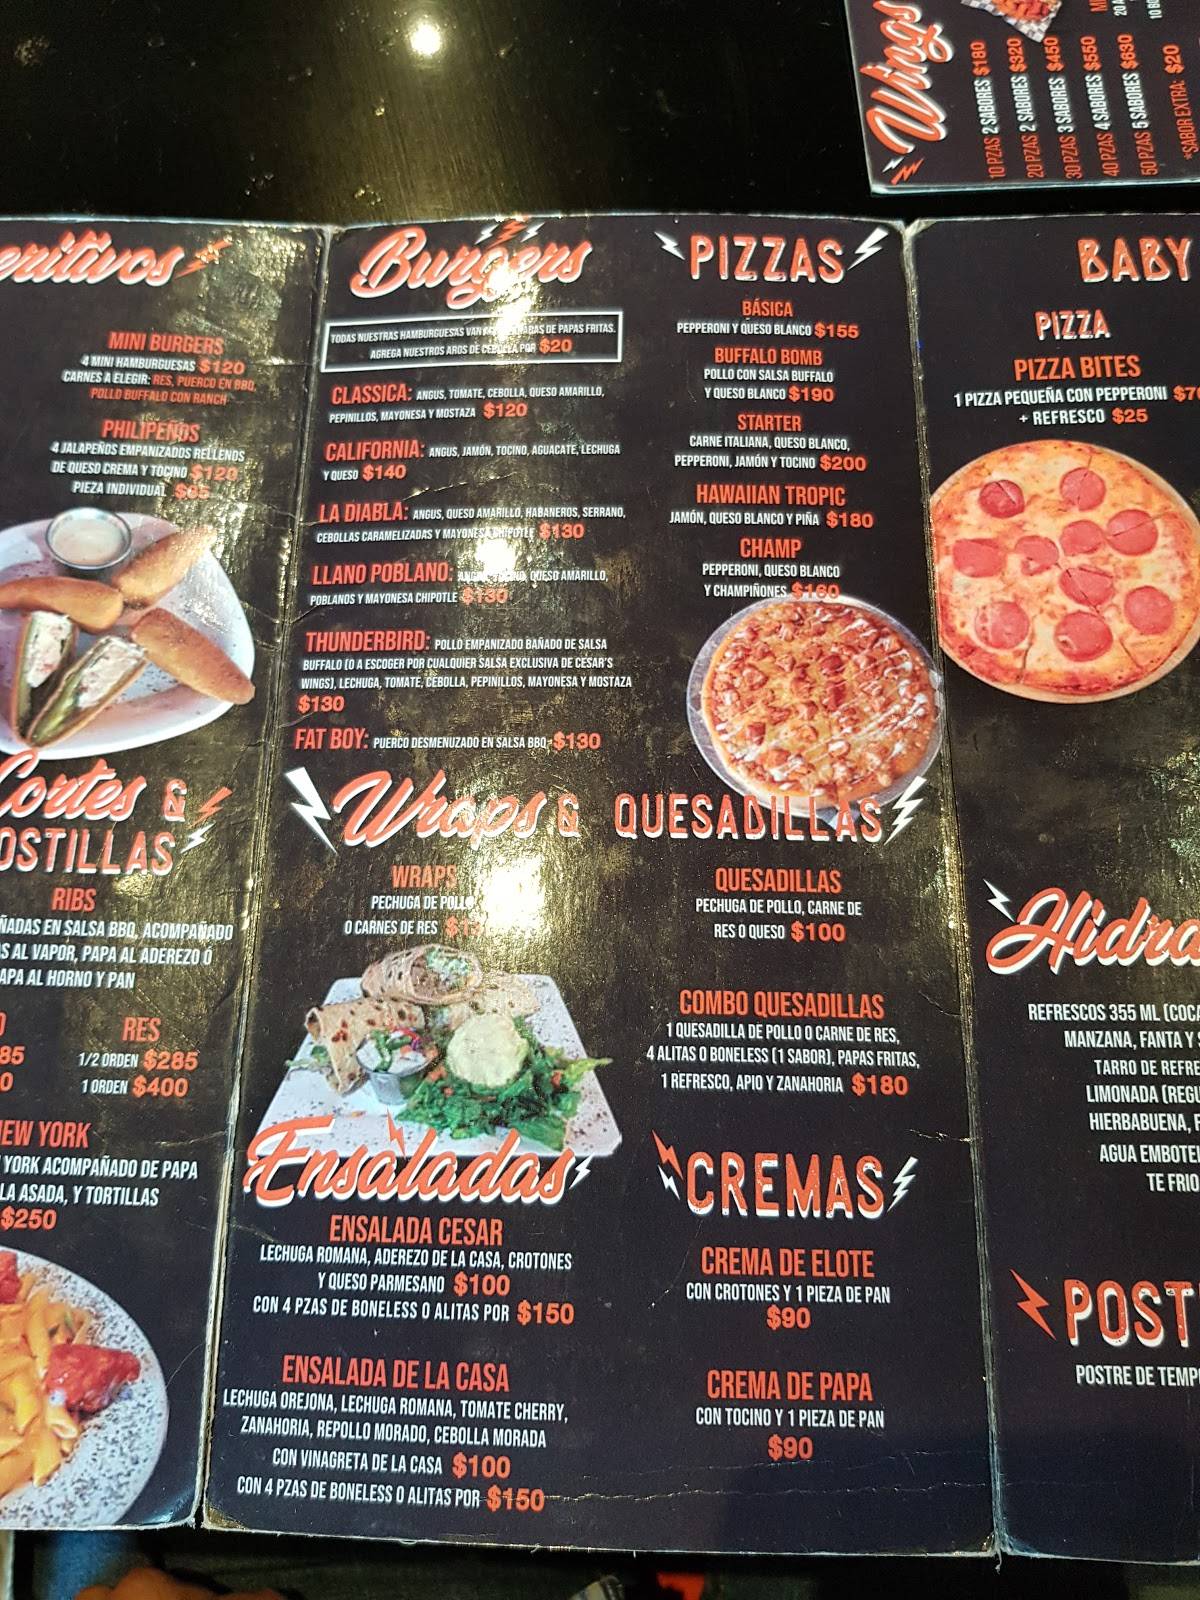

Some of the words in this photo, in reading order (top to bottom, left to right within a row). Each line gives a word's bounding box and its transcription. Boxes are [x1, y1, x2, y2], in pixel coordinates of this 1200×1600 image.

[970, 41, 991, 76] $180
[1007, 38, 1027, 73] $320
[1163, 44, 1184, 74] $20
[860, 0, 953, 154] Wings
[974, 78, 997, 125] SABORES
[1011, 75, 1035, 122] SABORES
[1168, 80, 1190, 114] EXTRA:
[982, 124, 999, 134] 2
[1019, 124, 1037, 132] 2
[984, 136, 1004, 165] PZAS
[1020, 134, 1042, 165] PZAS
[988, 166, 1006, 179] 10
[1027, 166, 1045, 179] 20
[350, 226, 592, 310] Burgers
[690, 235, 844, 284] PIZZAS
[1077, 236, 1192, 282] BABY
[742, 298, 793, 317] BÁSICA
[677, 322, 730, 333] PEPPERONI
[732, 323, 739, 334] Y
[740, 324, 772, 335] QUESO
[774, 325, 812, 336] BLANCO
[814, 322, 859, 339] $155
[1035, 309, 1111, 340] PIZZA
[108, 332, 146, 351] MINI
[150, 333, 224, 355] BURGERS
[81, 355, 88, 366] 4
[90, 356, 113, 368] MINI
[115, 357, 195, 371] HAMBURGUESAS
[198, 360, 244, 375] $120
[714, 347, 777, 364] BUFFALO
[781, 349, 822, 365] BOMB
[1014, 357, 1076, 381] PIZZA
[1080, 355, 1141, 378] BITES
[332, 383, 413, 405] CLASSICA:
[416, 388, 446, 401] ANGUS,
[449, 388, 485, 400] TOMATE,
[487, 387, 527, 399] CEBOLLA,
[529, 387, 557, 399] QUESO
[559, 386, 604, 398] AMARILLO,
[954, 393, 961, 407] 1
[965, 391, 1002, 406] PIZZA
[1004, 387, 1062, 405] PEQUEÑA
[1066, 388, 1093, 403] CON
[1095, 386, 1168, 402] PEPPERONI
[329, 411, 379, 423] PEPINILLOS,
[381, 410, 426, 421] MAYONESA
[428, 409, 434, 419] Y
[436, 407, 476, 419] MOSTAZA
[483, 402, 528, 419] $120
[737, 414, 802, 431] STARTER
[1033, 409, 1105, 425] REFRESCO
[1111, 407, 1148, 424] $25
[696, 484, 780, 505] HAWAIIAN
[785, 485, 846, 506] TROPIC
[669, 509, 707, 525] JAMÓN,
[709, 512, 742, 524] QUESO
[744, 513, 784, 525] BLANCO
[785, 514, 792, 525] Y
[795, 511, 819, 526] PIÑA
[826, 511, 874, 529] $180
[739, 538, 801, 558] CHAMP
[312, 564, 367, 586] LLANO
[371, 562, 453, 583] POBLANO:
[306, 630, 430, 652] THUNDERBIRD:
[435, 639, 463, 651] POLLO
[465, 639, 523, 650] EMPANIZADO
[526, 637, 562, 650] BAÑADO
[564, 639, 576, 649] DE
[578, 638, 607, 649] SALSA
[298, 695, 344, 713] $130
[295, 728, 326, 749] FAT
[330, 727, 368, 749] BOY:
[0, 748, 147, 821] Cortes
[163, 778, 187, 822] &
[332, 770, 547, 850] Wraps
[558, 794, 581, 838] &
[614, 793, 883, 843] QUESADILLAS
[0, 827, 176, 875] OSTILLAS
[392, 864, 457, 889] WRAPS
[715, 868, 841, 893] QUESADILLAS
[52, 887, 97, 911] RIBS
[714, 924, 736, 938] RES
[738, 924, 746, 938] O
[749, 924, 785, 939] QUESO
[790, 921, 845, 942] $100
[26, 970, 43, 986] AL
[47, 970, 93, 987] HORNO
[95, 972, 105, 987] Y
[108, 972, 135, 989] PAN
[679, 989, 748, 1016] COMBO
[754, 991, 884, 1020] QUESADILLAS
[1028, 1003, 1106, 1021] REFRESCOS
[1109, 1004, 1137, 1021] 355
[1140, 1004, 1160, 1021] ML
[122, 1017, 161, 1042] RES
[1064, 1031, 1137, 1050] MANZANA,
[1139, 1031, 1183, 1048] FANTA
[1185, 1031, 1194, 1048] Y
[78, 1053, 100, 1066] 1/2
[102, 1053, 139, 1068] ORDEN
[143, 1049, 199, 1070] $285
[646, 1046, 655, 1060] 4
[657, 1046, 696, 1061] ALITAS
[699, 1047, 706, 1062] O
[710, 1047, 768, 1063] BONELESS
[838, 1051, 874, 1066] PAPAS
[878, 1052, 920, 1069] FRITAS,
[1094, 1060, 1137, 1075] TARRO
[1141, 1060, 1158, 1076] DE
[81, 1079, 88, 1092] 1
[90, 1080, 128, 1094] ORDEN
[132, 1075, 189, 1097] $400
[1086, 1085, 1159, 1103] LIMONADA
[1089, 1113, 1192, 1133] HIERBABUENA,
[243, 1114, 575, 1207] Ensaladas
[1100, 1144, 1137, 1162] AGUA
[687, 1152, 884, 1219] CREMAS
[1146, 1173, 1165, 1192] TE
[1168, 1173, 1200, 1192] FRIO
[1, 1206, 57, 1230] $250
[329, 1215, 432, 1244] ENSALADA
[438, 1217, 503, 1246] CESAR
[701, 1247, 773, 1276] CREMA
[779, 1248, 806, 1277] DE
[812, 1250, 875, 1278] ELOTE
[318, 1272, 326, 1289] Y
[329, 1273, 367, 1291] QUESO
[370, 1274, 444, 1293] PARMESANO
[454, 1272, 510, 1296] $100
[686, 1282, 711, 1300] CON
[715, 1283, 780, 1302] CROTONES
[783, 1285, 791, 1302] Y
[796, 1285, 802, 1302] 1
[806, 1285, 842, 1303] PIEZA
[846, 1286, 862, 1303] DE
[865, 1286, 891, 1304] PAN
[766, 1304, 811, 1330] $90
[1064, 1279, 1200, 1348] POST
[282, 1354, 387, 1388] ENSALADA
[392, 1359, 419, 1389] DE
[424, 1360, 450, 1390] LA
[456, 1361, 510, 1392] CASA
[1076, 1365, 1132, 1384] POSTRE
[1135, 1366, 1155, 1385] DE
[241, 1416, 314, 1438] ZANAHORIA,
[316, 1420, 371, 1440] REPOLLO
[374, 1422, 430, 1445] MORADO,
[434, 1424, 490, 1446] CEBOLLA
[493, 1427, 547, 1448] MORADA
